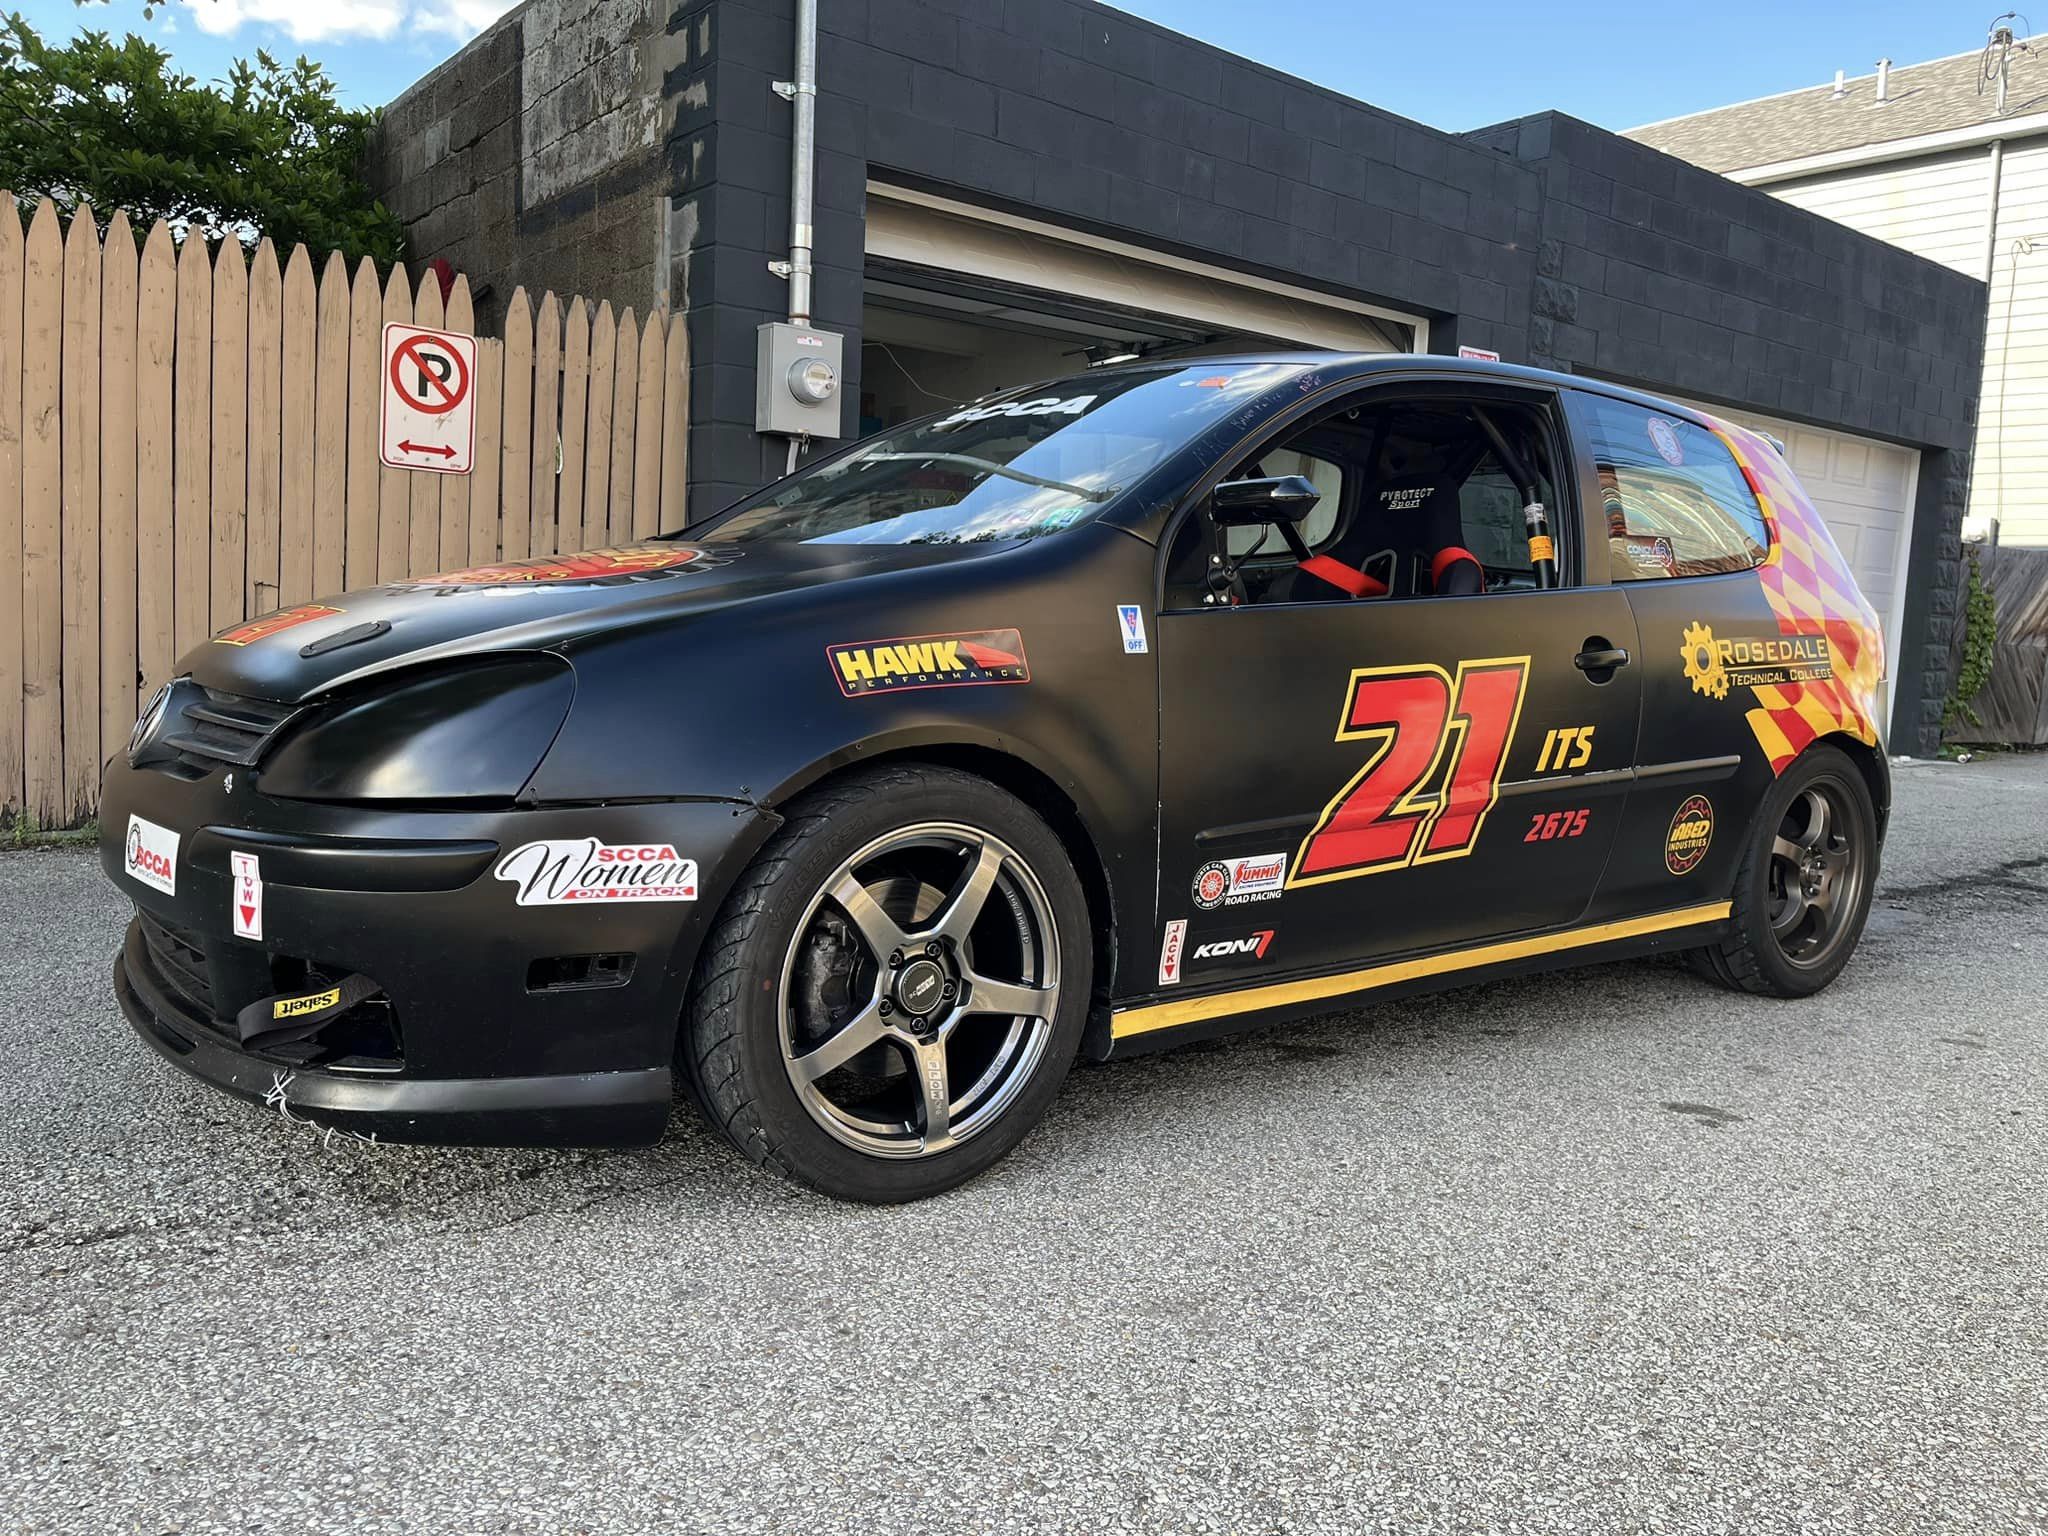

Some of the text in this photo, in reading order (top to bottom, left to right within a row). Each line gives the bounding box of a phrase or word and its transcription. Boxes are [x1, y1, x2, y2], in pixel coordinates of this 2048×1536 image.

[418, 352, 452, 397] P
[932, 394, 1098, 428] SCCA
[1380, 487, 1435, 501] PYROTECT
[1389, 499, 1421, 509] Sport
[1128, 640, 1143, 650] OFF
[1716, 638, 1828, 665] ROSEDALE
[836, 640, 967, 682] HAWK
[847, 668, 1025, 691] PERFORMANCE
[1730, 667, 1833, 687] TECHNICAL COLLEGE
[1535, 726, 1596, 773] ITS
[1284, 655, 1531, 890] 21
[1523, 808, 1591, 843] 2675
[598, 847, 676, 862] SCCA
[1668, 838, 1707, 851] INDUSTRIES
[137, 845, 172, 881] SCCA
[500, 840, 695, 902] Women
[1211, 862, 1223, 870] CAR
[241, 861, 254, 902] TOW
[575, 886, 687, 899] ON TRACK
[1224, 889, 1282, 906] ROAD RACING
[1166, 924, 1180, 963] JACK
[1193, 937, 1261, 959] KONI
[282, 994, 333, 1014] Sabelt
